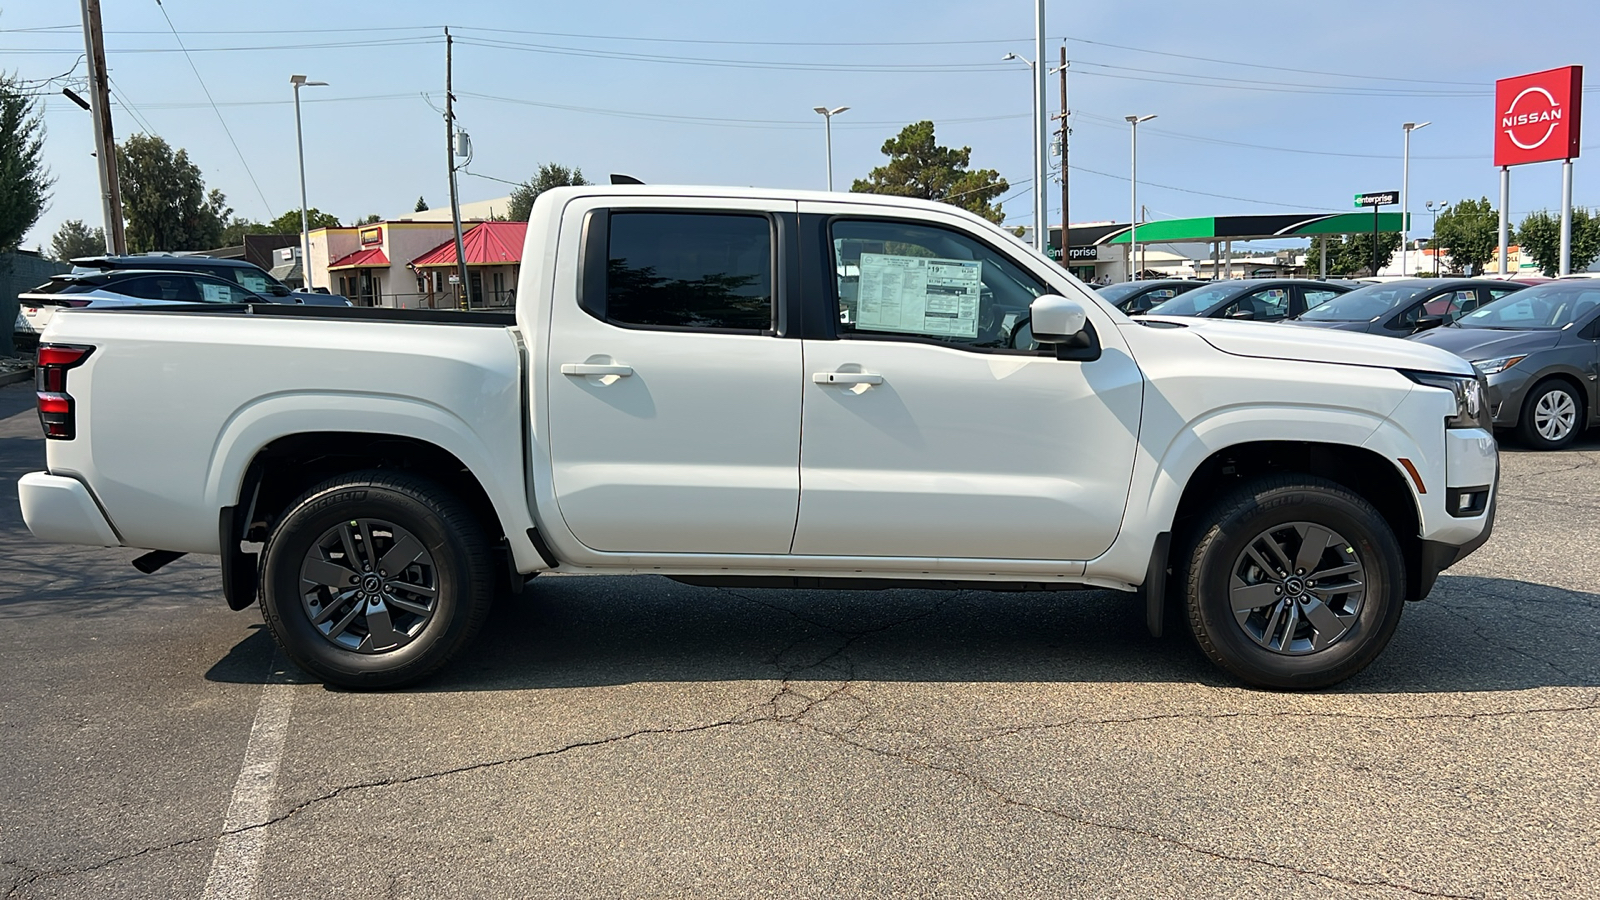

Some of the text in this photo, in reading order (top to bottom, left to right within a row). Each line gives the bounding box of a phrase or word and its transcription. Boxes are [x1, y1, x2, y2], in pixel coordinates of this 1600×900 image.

[1502, 108, 1562, 128] NISSAN
[1356, 194, 1393, 205] enterprise
[1047, 247, 1097, 259] entrprise
[303, 490, 367, 515] MICHELIN
